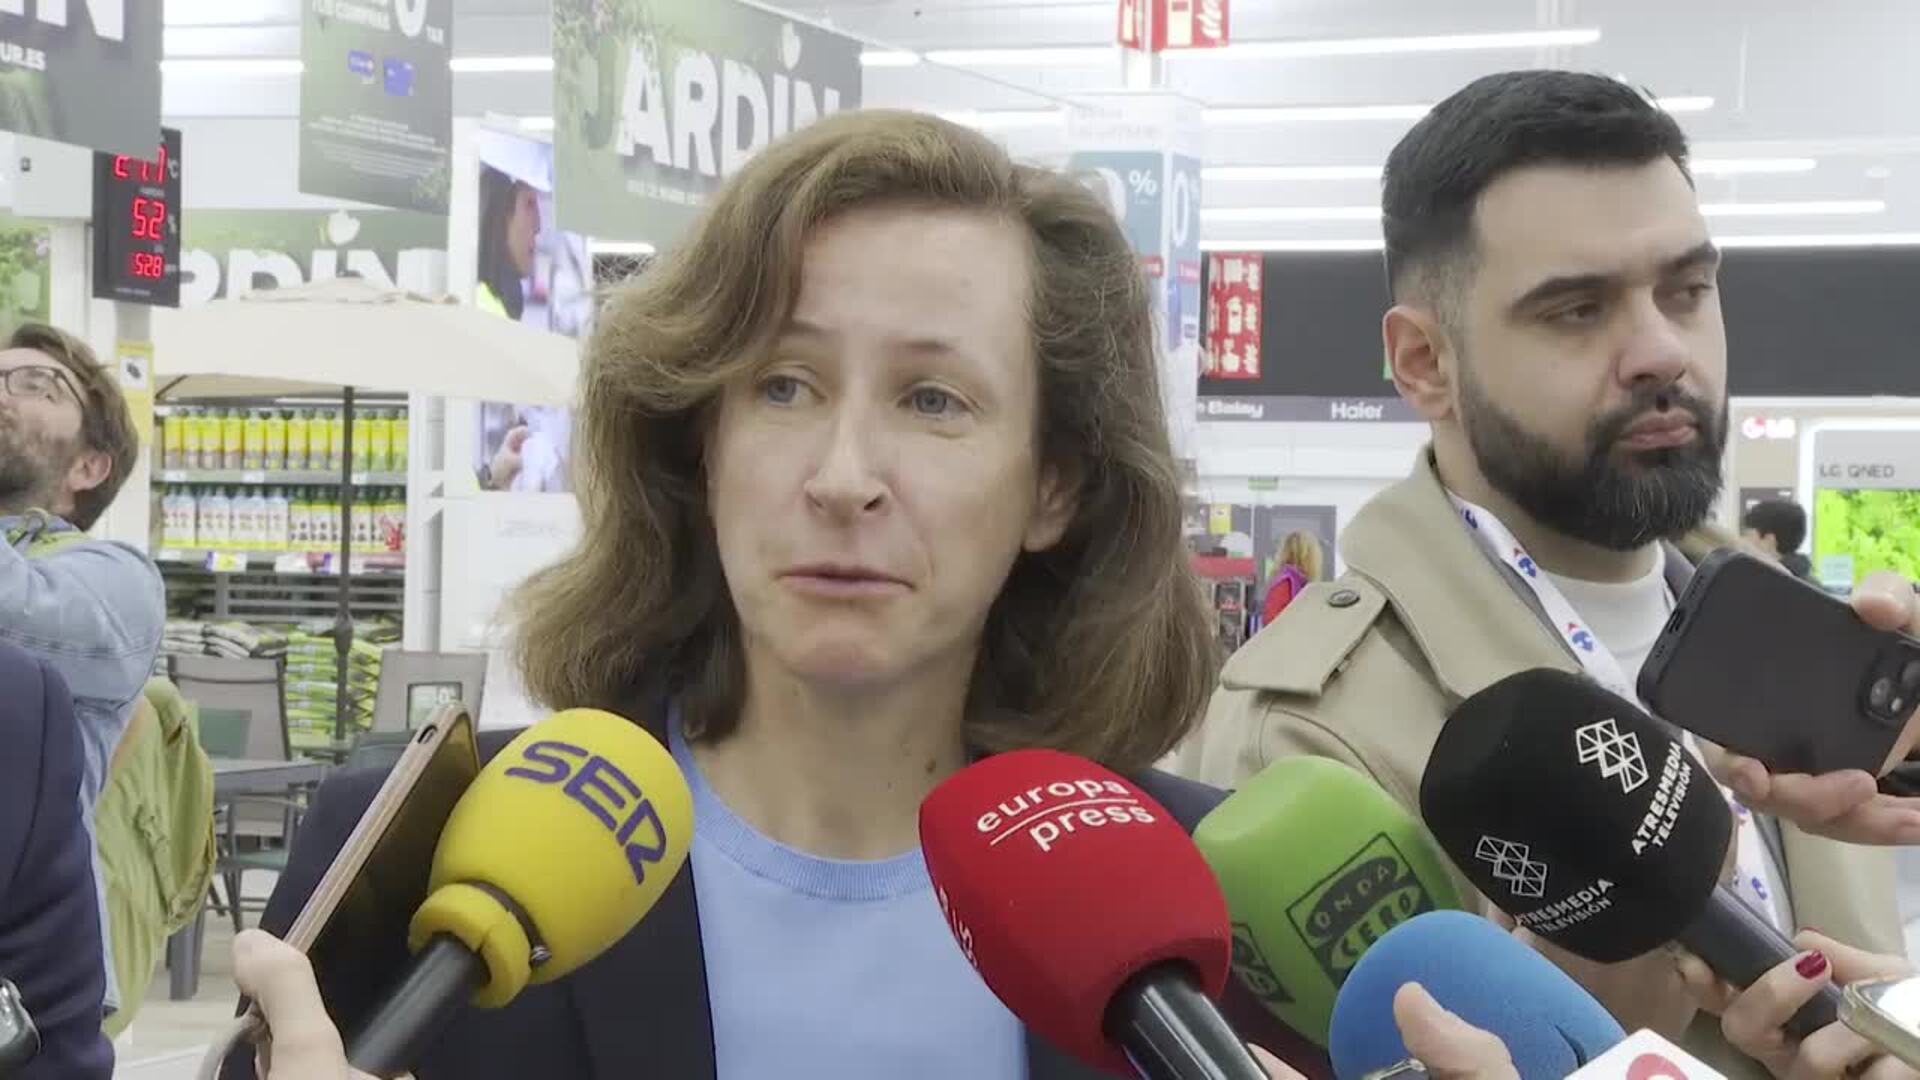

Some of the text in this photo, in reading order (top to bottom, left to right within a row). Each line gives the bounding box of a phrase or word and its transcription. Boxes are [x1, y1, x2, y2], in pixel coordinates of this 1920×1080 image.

[132, 197, 166, 240] 52
[134, 252, 163, 279] 528
[1331, 402, 1384, 420] Haier
[1819, 464, 1895, 479] LG QNED
[503, 740, 667, 886] SER
[976, 779, 1130, 833] europa
[1631, 740, 1682, 856] ATRESMEDIA
[1029, 805, 1156, 852] press
[1314, 864, 1390, 929] ONDA
[1513, 878, 1614, 927] ATRESMEDIA
